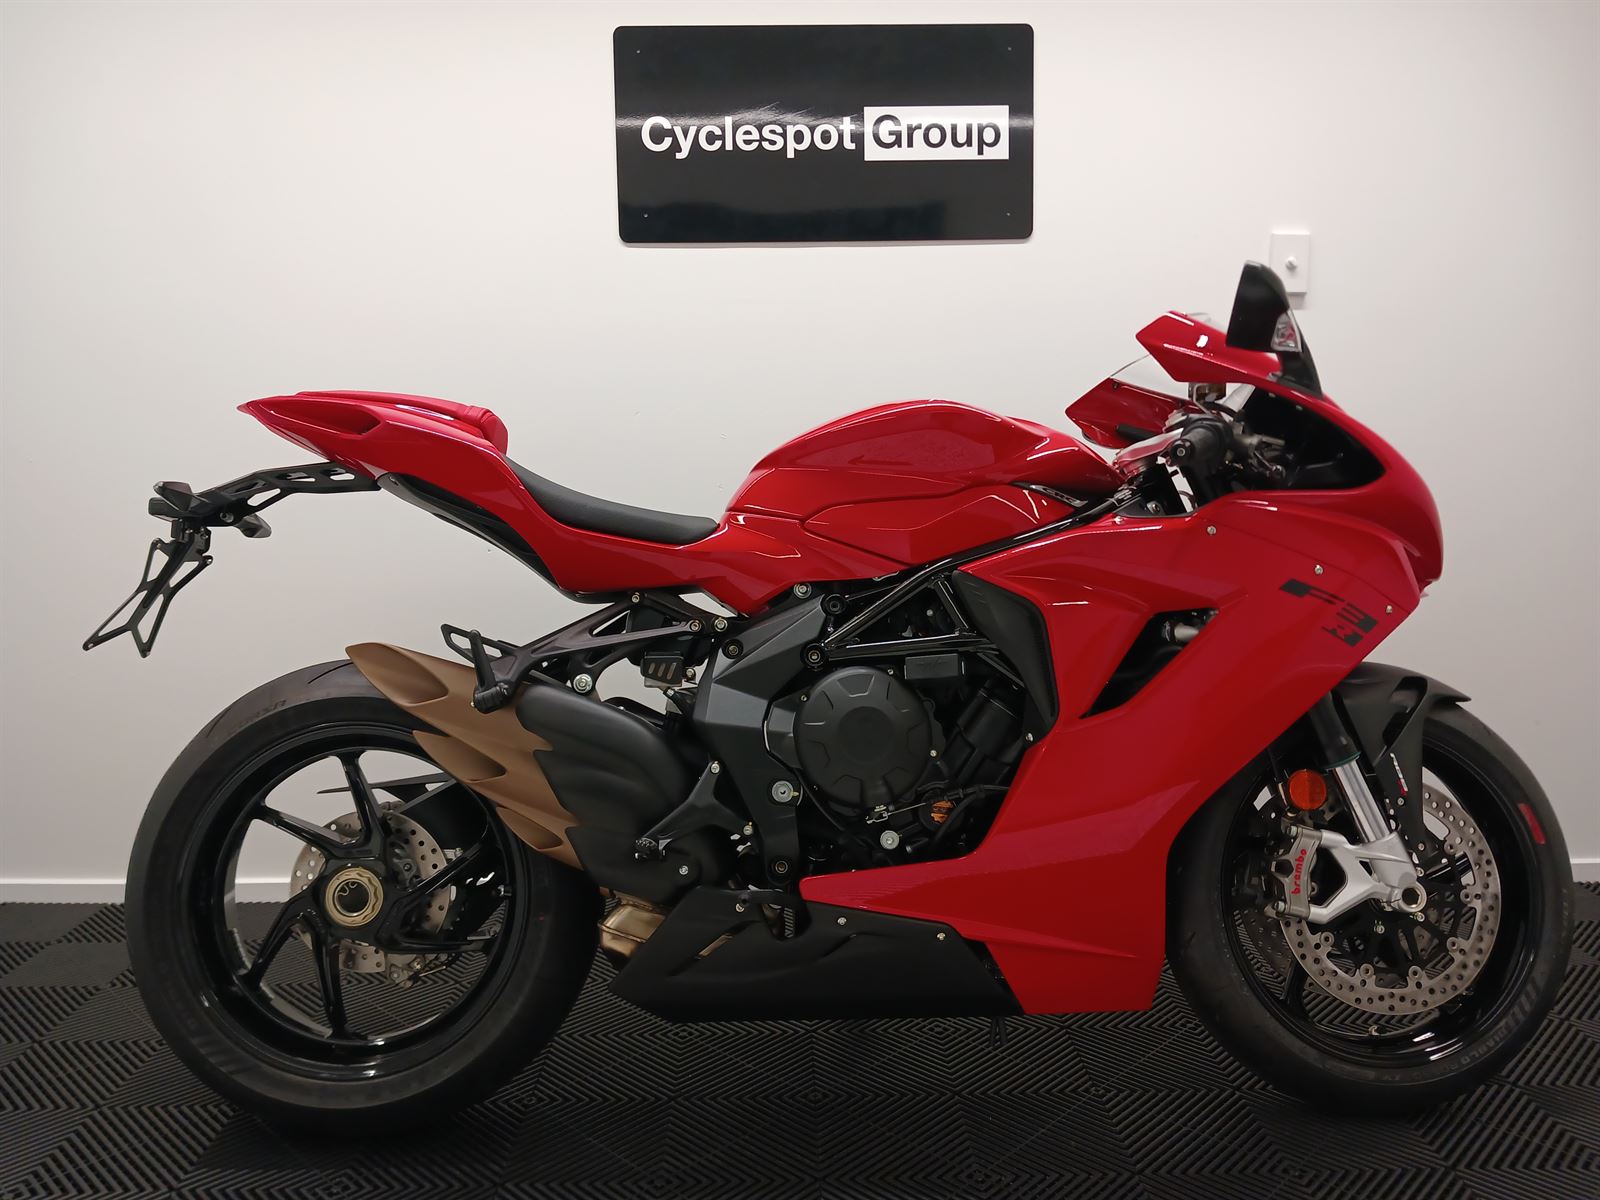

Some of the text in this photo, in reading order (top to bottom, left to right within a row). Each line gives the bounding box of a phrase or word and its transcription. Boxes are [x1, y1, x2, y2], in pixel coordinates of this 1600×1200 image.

[640, 114, 1002, 160] Cyclespot Group
[1290, 848, 1308, 895] brembo
